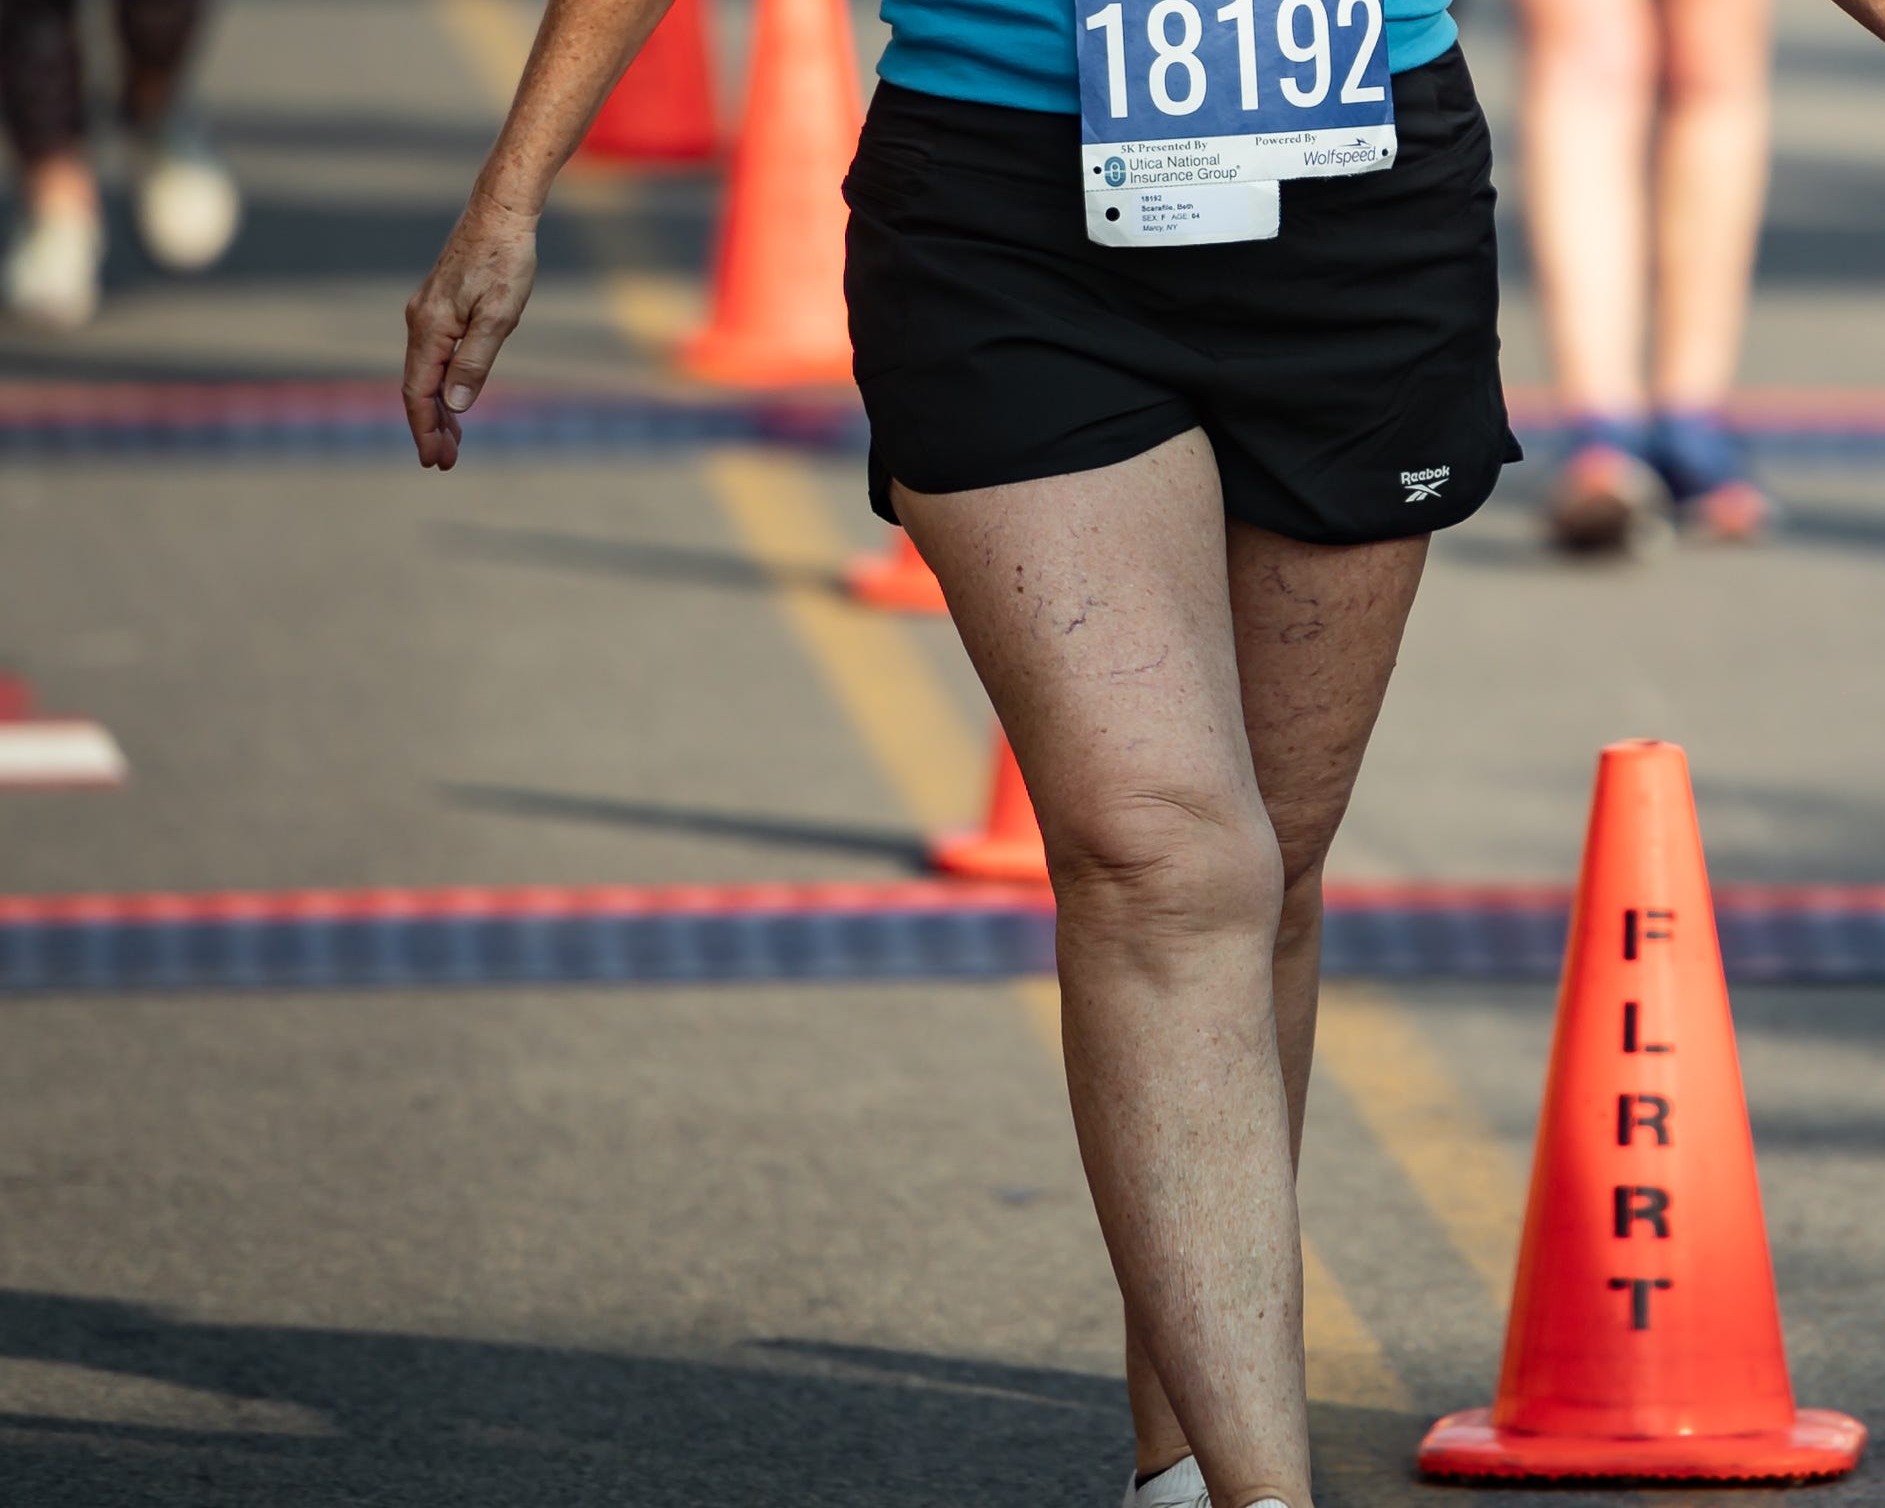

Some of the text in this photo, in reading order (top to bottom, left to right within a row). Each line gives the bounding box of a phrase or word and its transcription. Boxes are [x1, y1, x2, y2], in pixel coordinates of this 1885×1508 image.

[1121, 140, 1208, 153] 5K Presented By
[1255, 133, 1317, 146] Powered By
[1129, 153, 1220, 171] Utica National
[1303, 146, 1376, 167] Wolfspeed
[1130, 170, 1193, 184] Insurance
[1400, 465, 1450, 485] Reebok
